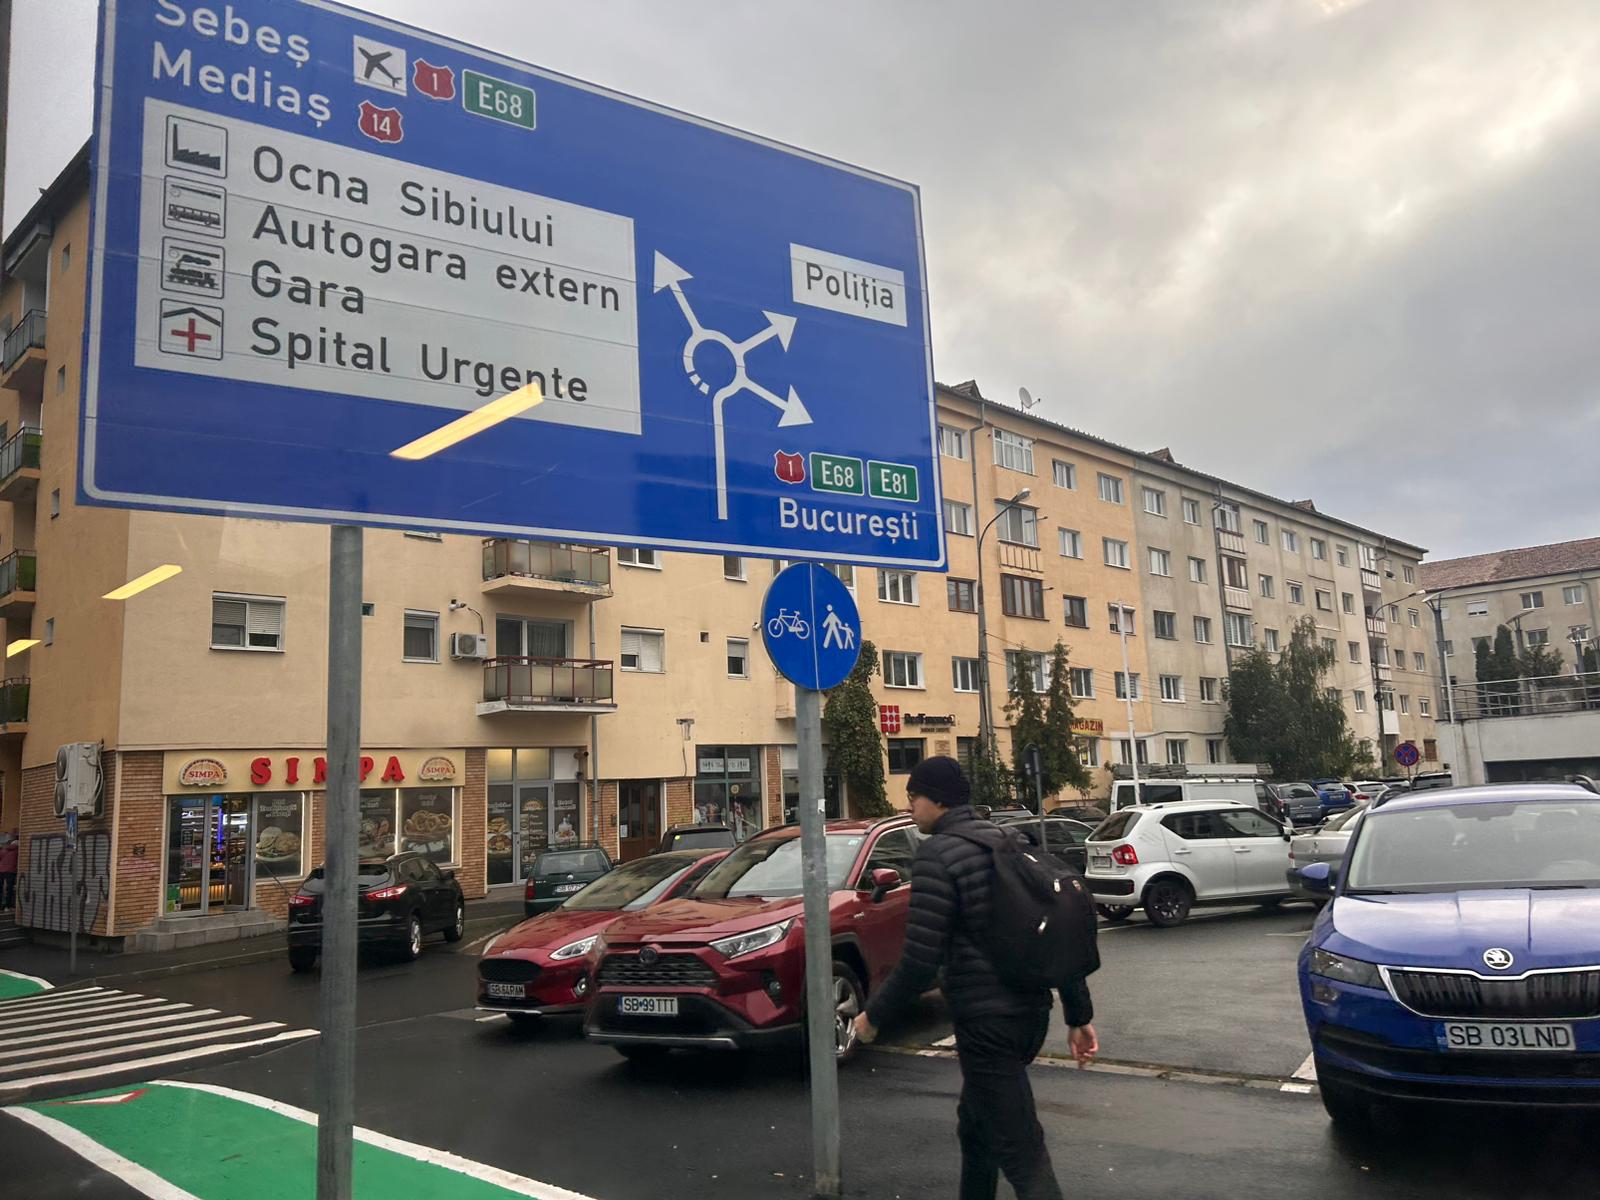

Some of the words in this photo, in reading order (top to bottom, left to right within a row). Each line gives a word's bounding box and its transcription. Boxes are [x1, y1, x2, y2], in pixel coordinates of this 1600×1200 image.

[154, 0, 311, 68] Sebeș
[151, 40, 331, 128] Mediaș
[430, 73, 440, 92] 1
[477, 82, 523, 119] E68
[371, 112, 392, 136] 14
[253, 145, 369, 204] Ocna
[399, 180, 554, 247] Sibiului
[252, 205, 467, 280] Autogara
[495, 262, 621, 312] extern
[250, 259, 364, 314] Gara
[805, 261, 894, 309] Poliția
[250, 317, 391, 373] Spital
[420, 343, 588, 402] Urgente
[787, 460, 794, 477] 1
[820, 459, 855, 489] E68
[880, 471, 909, 496] E81
[779, 497, 919, 545] București
[188, 770, 221, 778] SIMPA
[624, 998, 639, 1011] SB
[643, 998, 655, 1012] 99
[1449, 1025, 1482, 1046] SB
